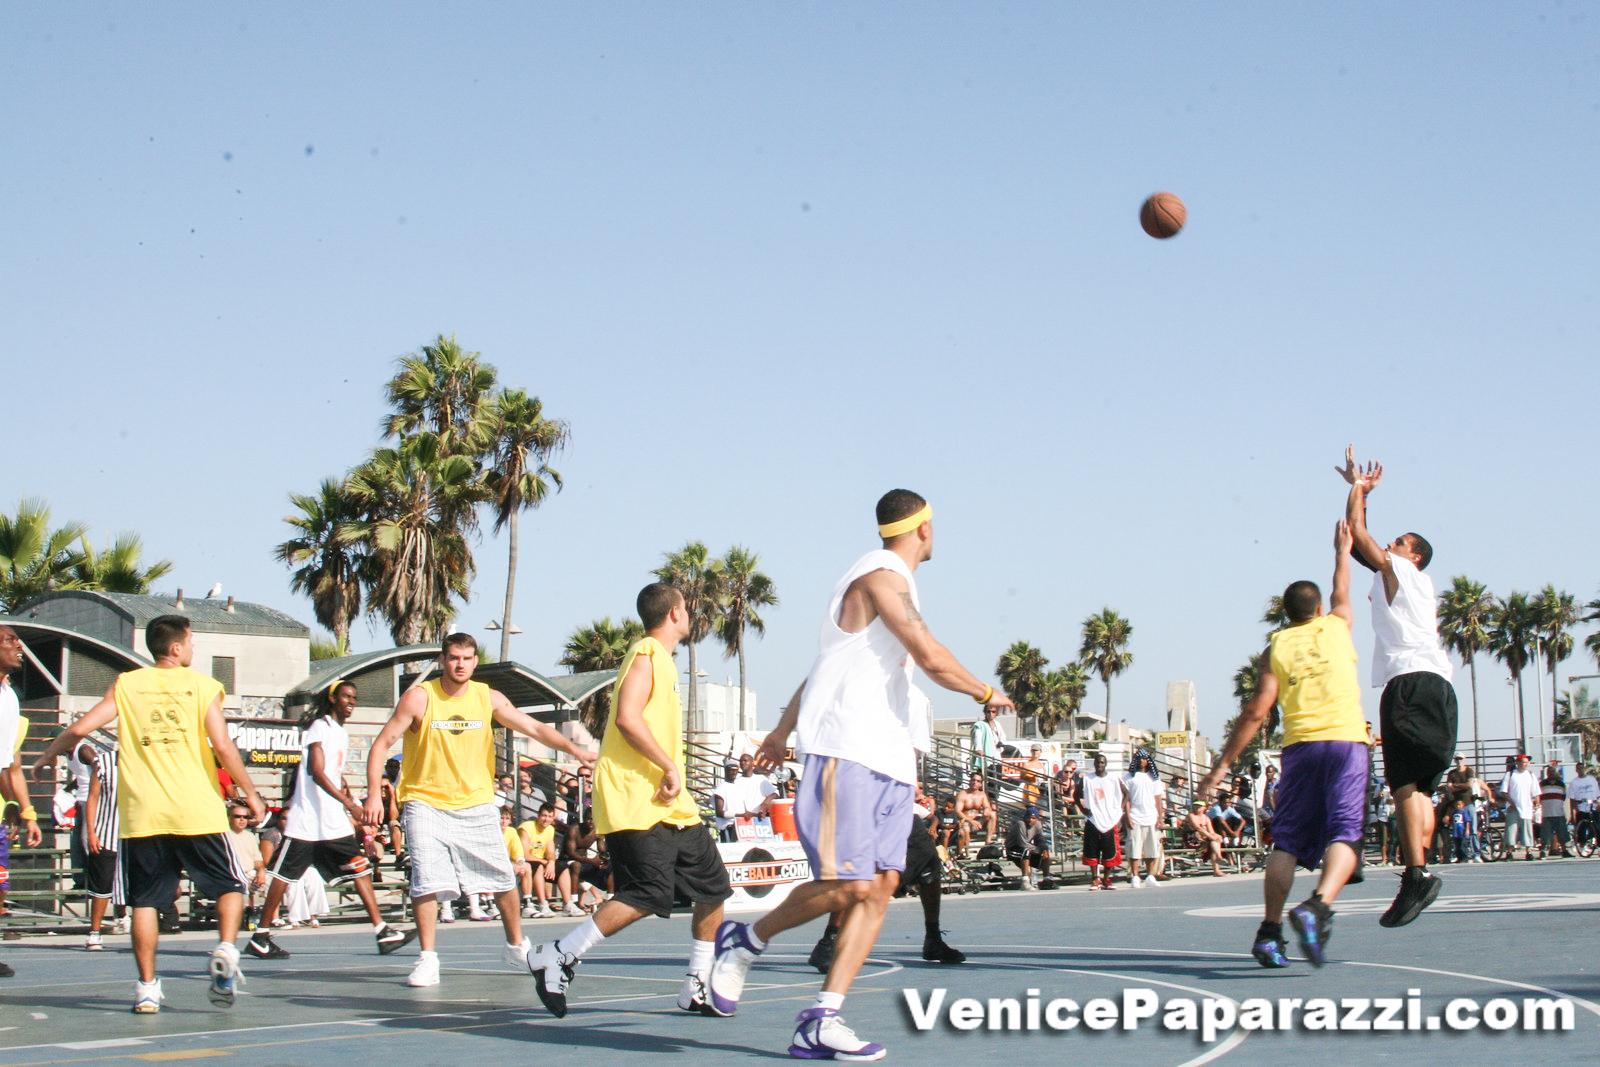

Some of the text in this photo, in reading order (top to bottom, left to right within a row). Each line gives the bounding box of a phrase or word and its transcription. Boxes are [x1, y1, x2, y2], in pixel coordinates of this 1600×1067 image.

[1159, 734, 1187, 744] Dream Tan
[251, 751, 266, 762] See
[267, 752, 274, 763] if
[274, 755, 288, 765] you
[738, 825, 772, 838] 06 02
[727, 863, 808, 880] ICEBALL.COM
